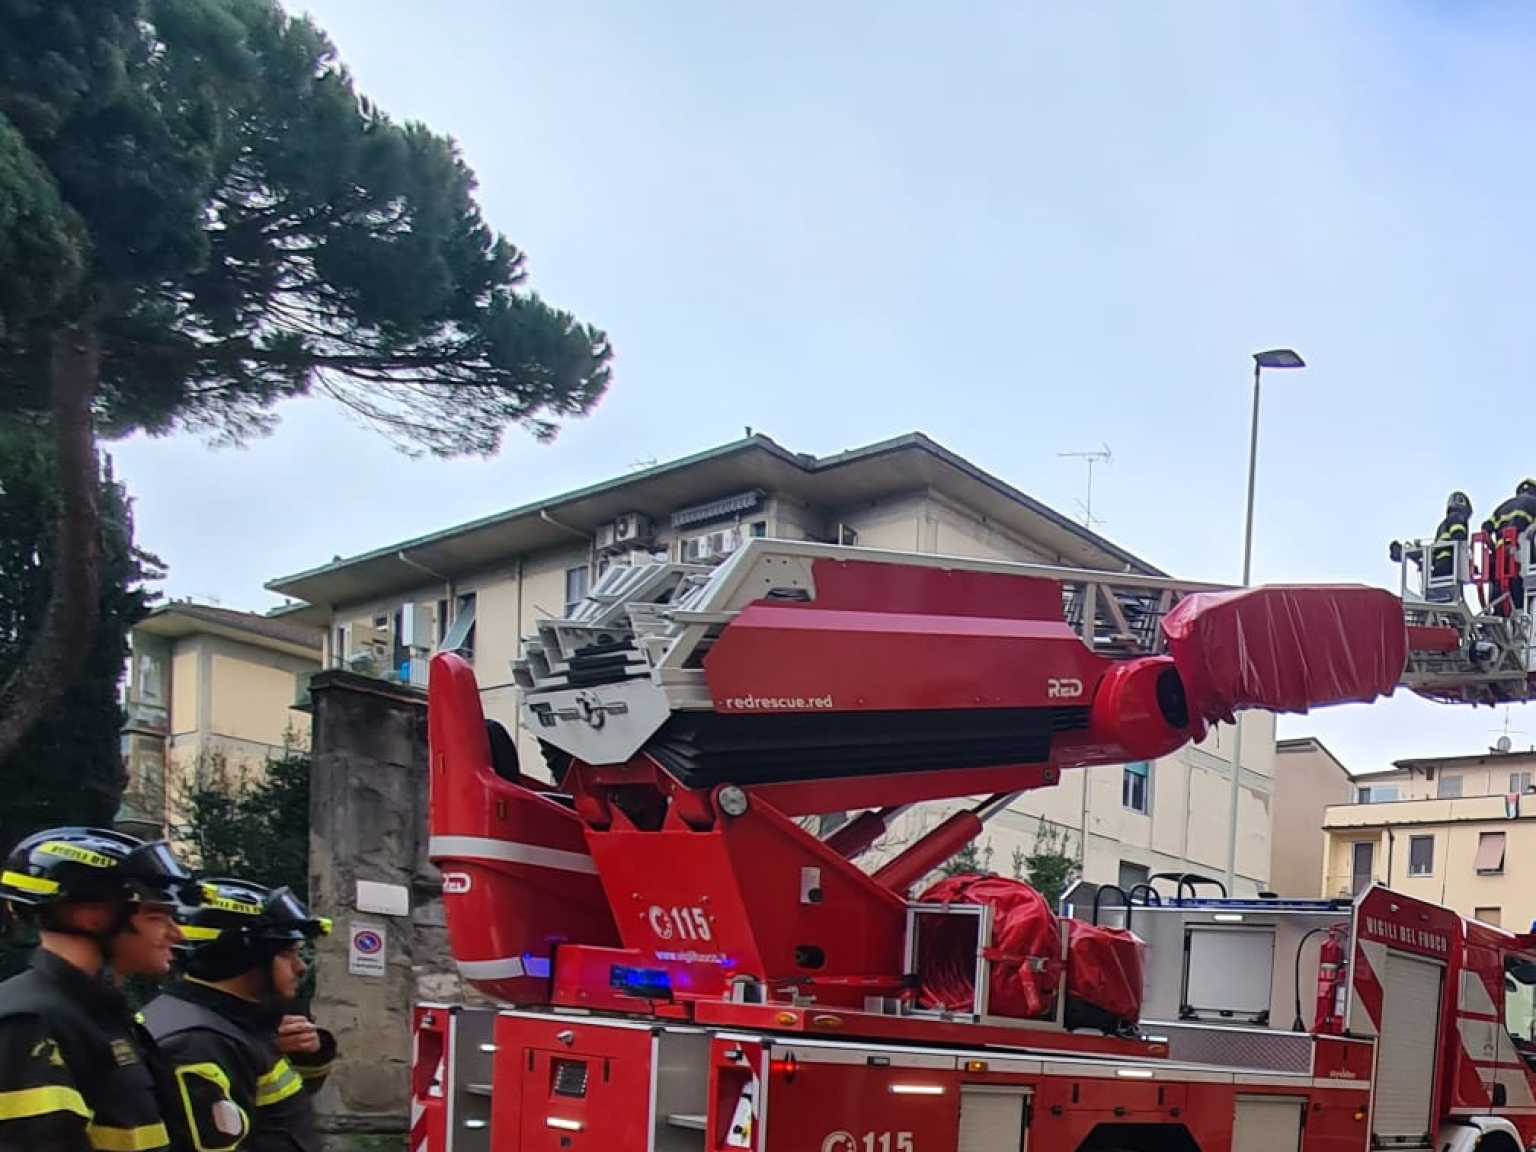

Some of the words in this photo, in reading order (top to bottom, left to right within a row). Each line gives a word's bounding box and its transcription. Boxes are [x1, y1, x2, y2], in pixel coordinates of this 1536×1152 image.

[1047, 678, 1083, 697] RED
[726, 693, 833, 709] redrescue.red
[671, 906, 712, 940] 115
[1366, 915, 1398, 940] VIGILI
[1399, 925, 1417, 945] DEL
[1418, 930, 1447, 952] FUOCO
